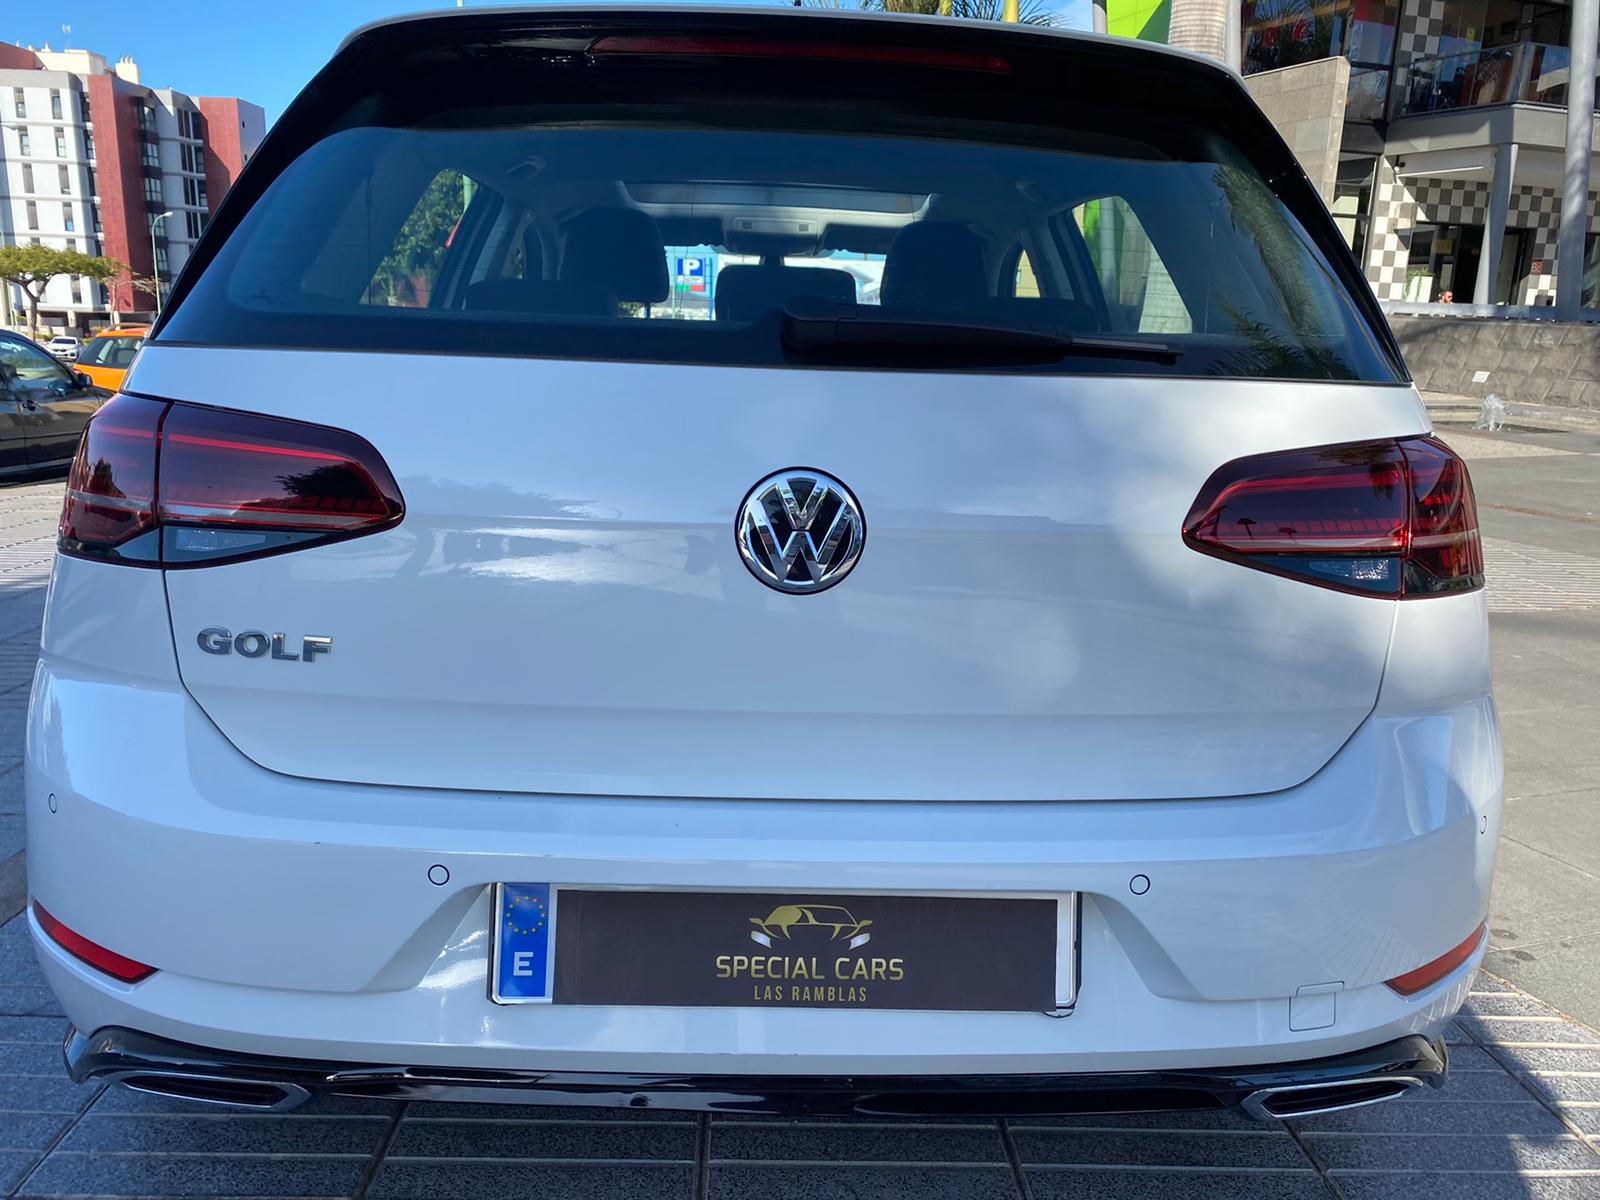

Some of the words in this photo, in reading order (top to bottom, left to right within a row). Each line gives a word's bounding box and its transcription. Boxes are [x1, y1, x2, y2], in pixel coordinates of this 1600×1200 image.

[682, 258, 700, 275] P
[197, 625, 333, 663] GOLF
[513, 951, 534, 977] E
[716, 955, 825, 980] SPECIAL
[834, 957, 905, 981] CARS
[754, 985, 784, 1001] LAS
[791, 986, 867, 1002] RAMBLAS
